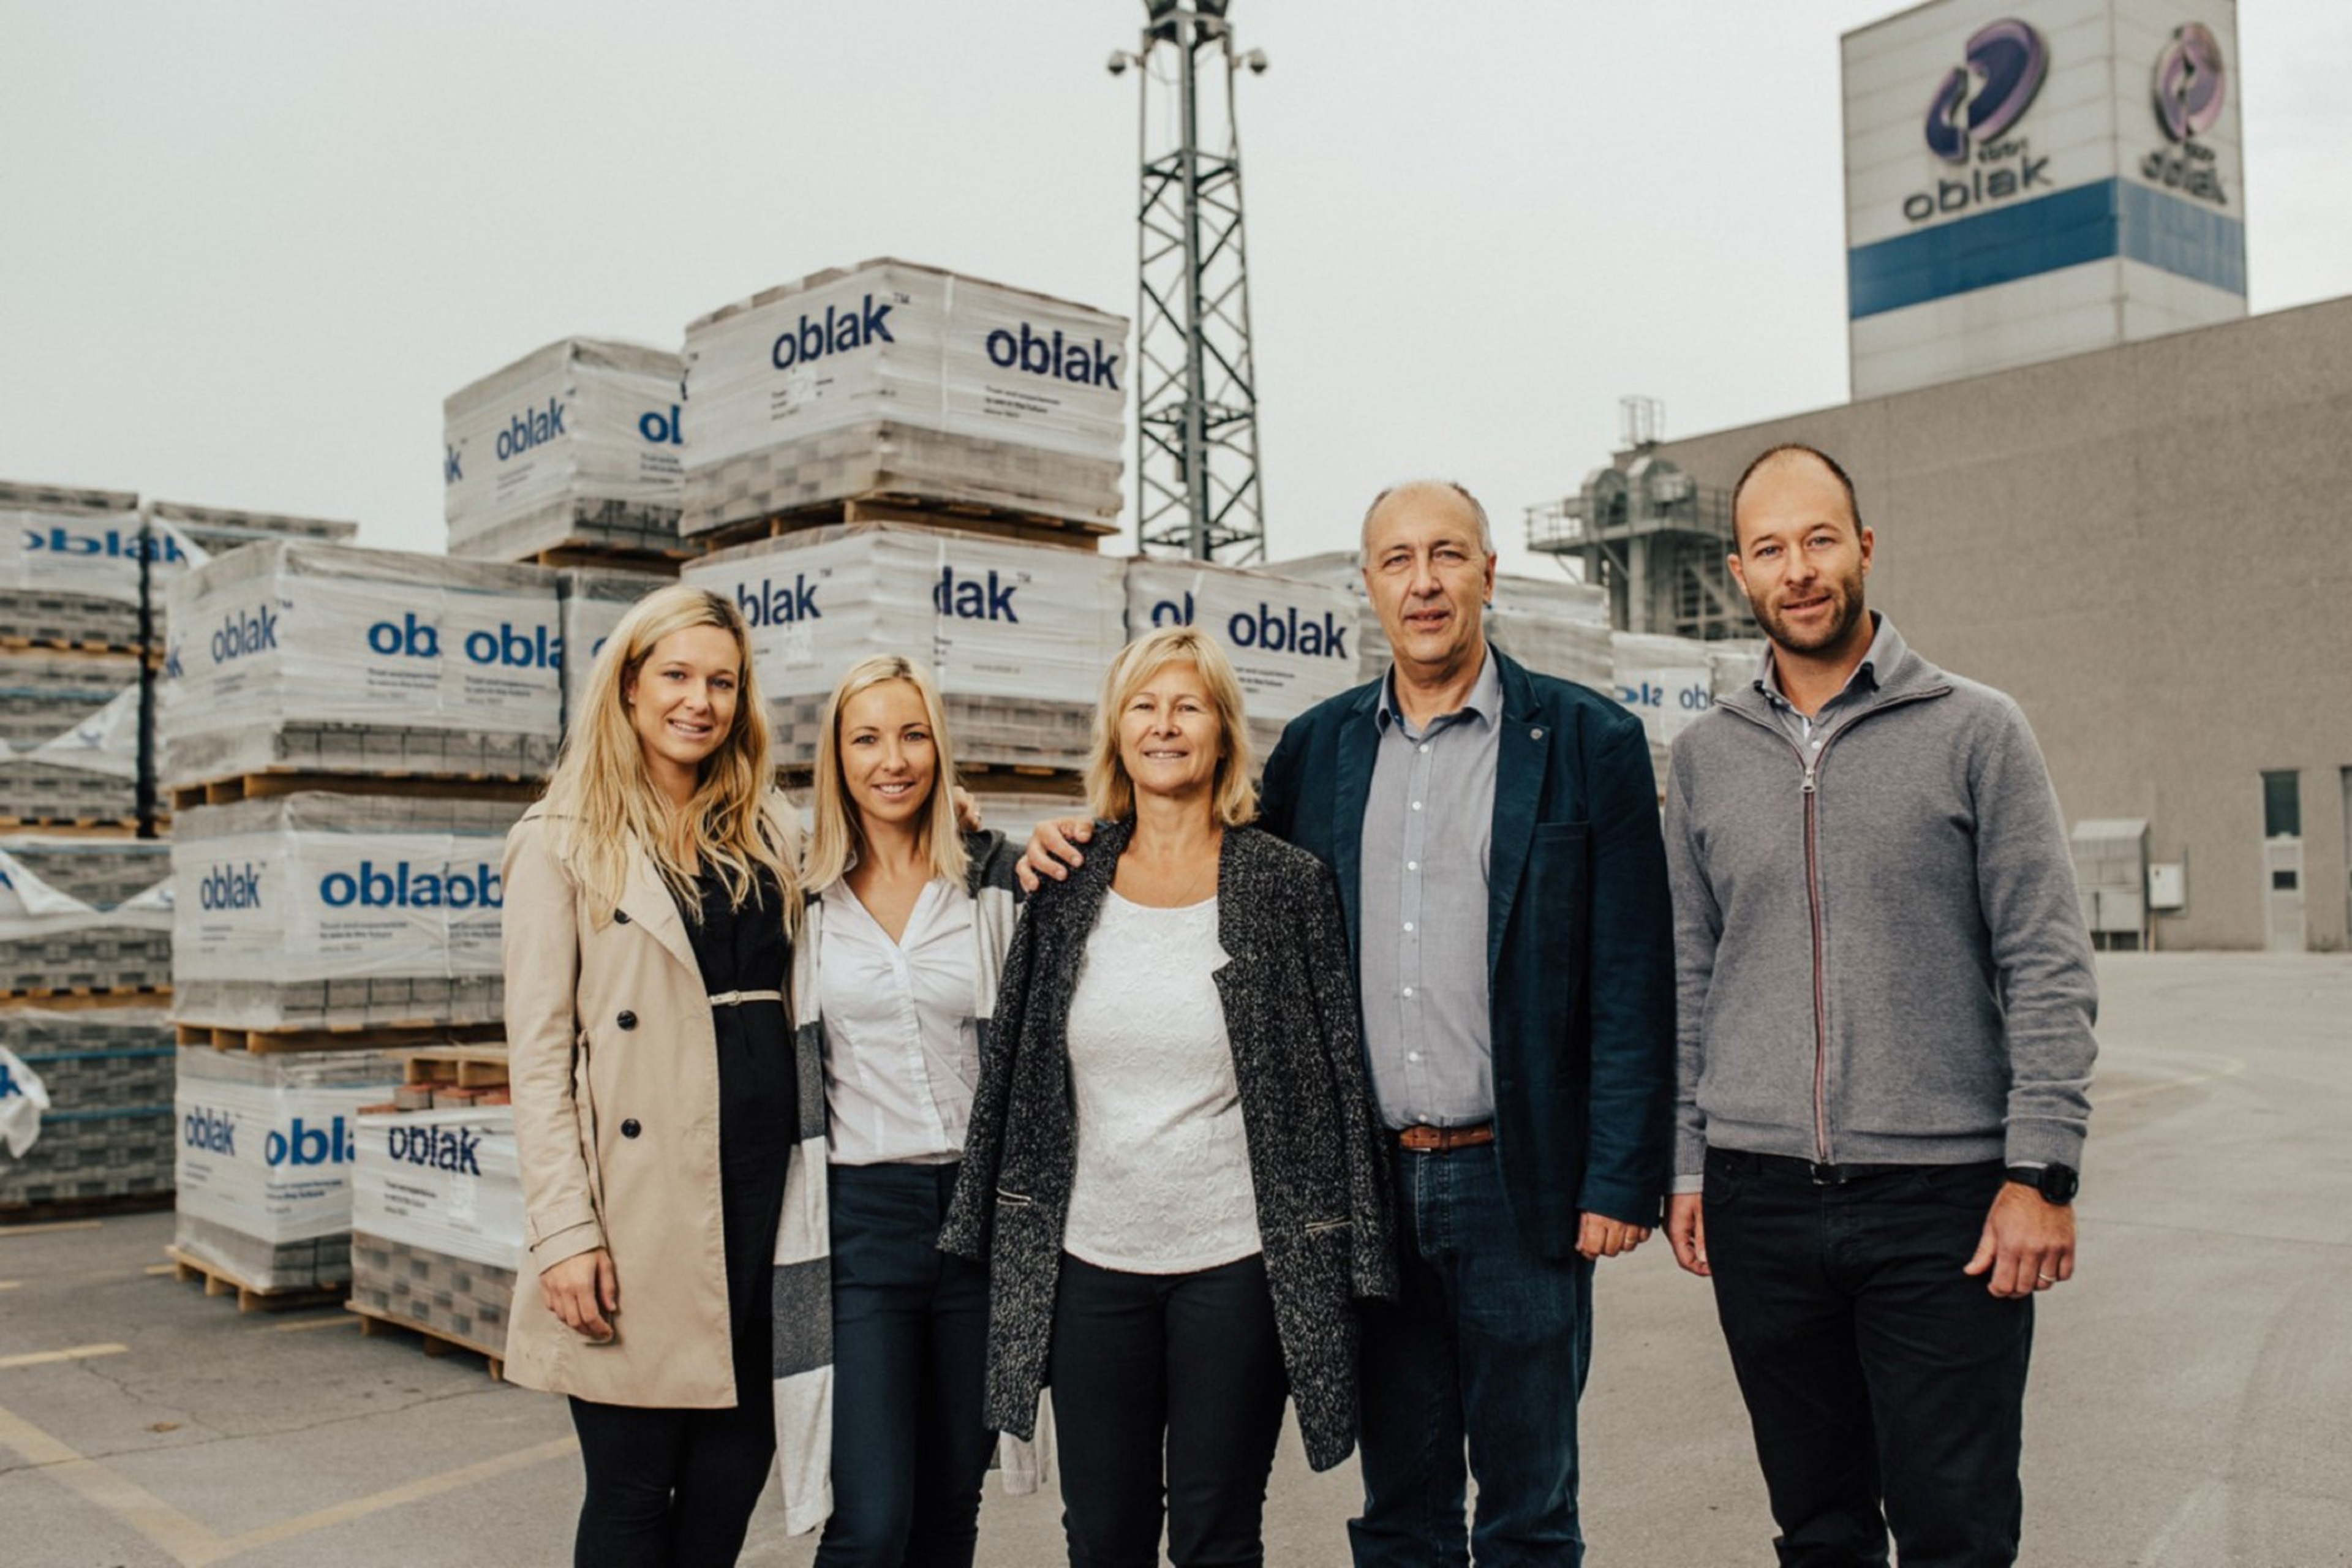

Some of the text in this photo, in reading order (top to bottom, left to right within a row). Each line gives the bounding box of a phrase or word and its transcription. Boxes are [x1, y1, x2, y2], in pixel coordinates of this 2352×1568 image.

[1902, 156, 2053, 223] oblak
[772, 293, 894, 370] oblak
[987, 322, 1120, 391] oblak
[497, 397, 565, 462] oblak
[212, 604, 277, 664] oblak
[1227, 602, 1348, 660] oblak
[201, 862, 261, 910] oblak
[185, 1105, 235, 1157] oblak
[388, 1125, 481, 1176] oblak
